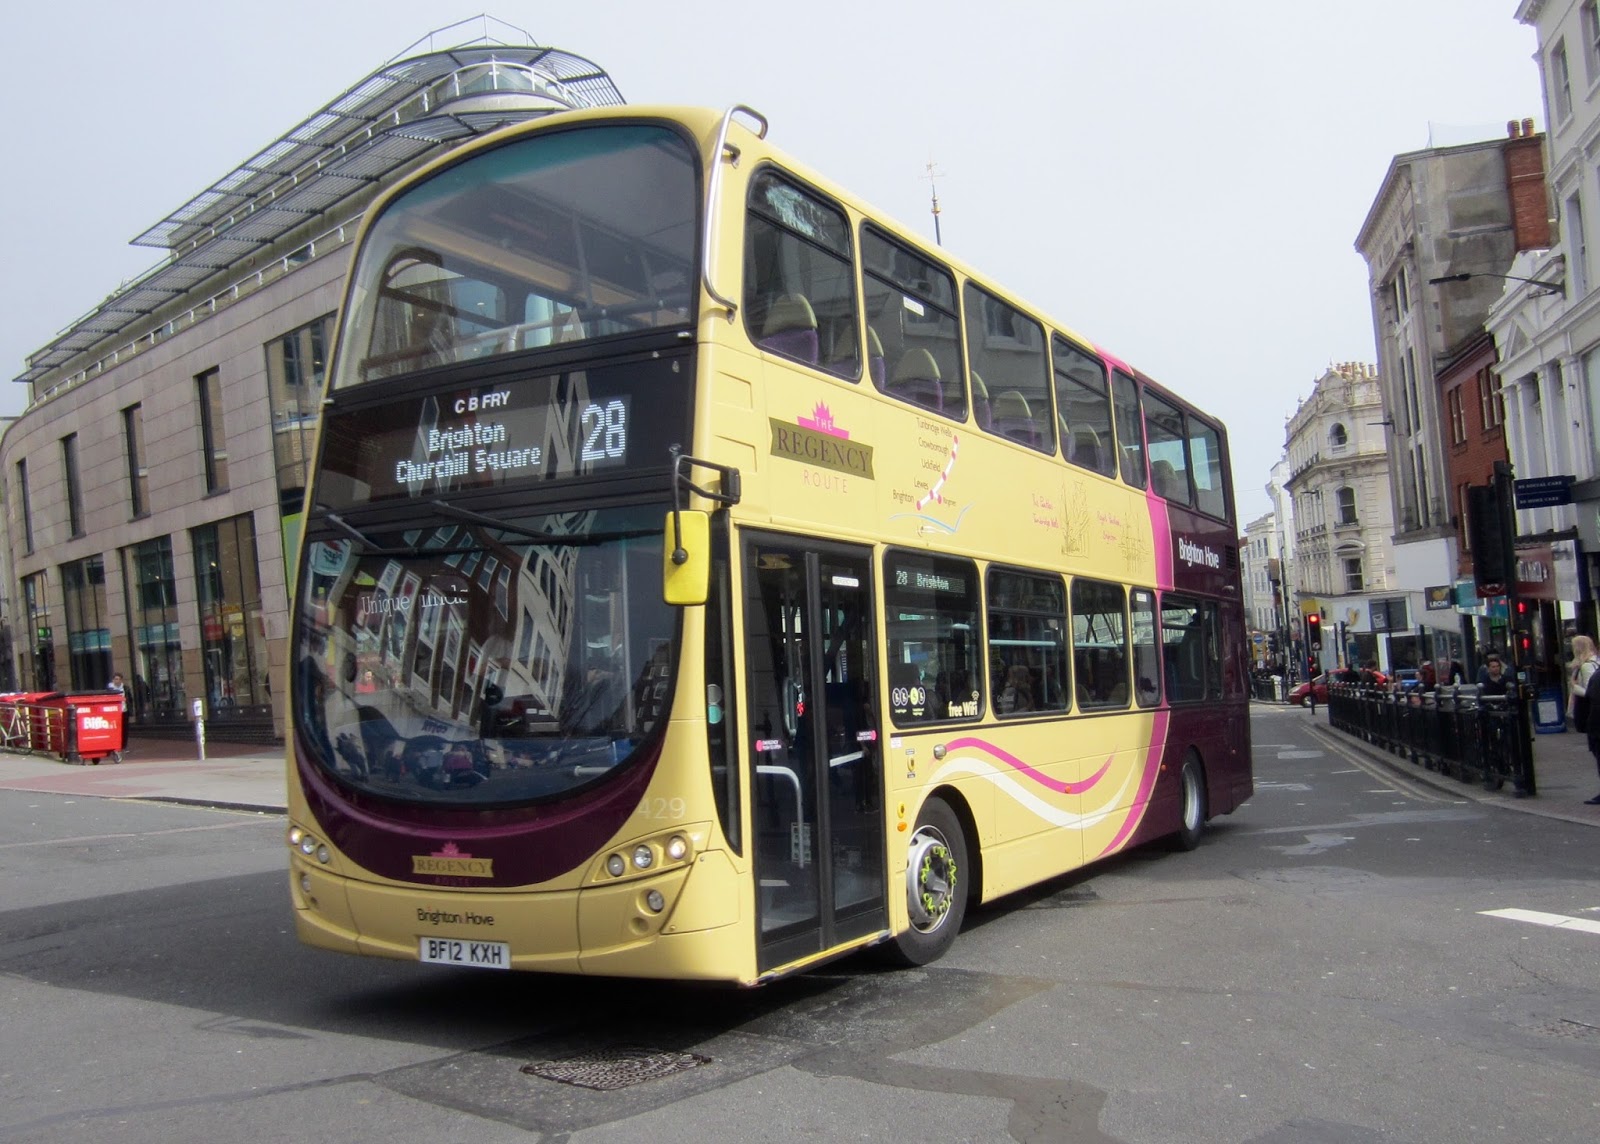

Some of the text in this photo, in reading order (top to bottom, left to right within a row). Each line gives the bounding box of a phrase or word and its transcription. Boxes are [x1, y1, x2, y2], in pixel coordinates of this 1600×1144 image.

[454, 390, 511, 414] C B FRY
[581, 400, 626, 461] 28
[815, 416, 834, 431] THE
[429, 422, 506, 452] Brighton
[777, 427, 870, 472] REGENCY
[396, 447, 541, 483] Churchill Square
[803, 469, 849, 494] ROUTE
[913, 476, 929, 490] Lewes
[892, 488, 915, 504] Brighton
[1179, 536, 1219, 569] Brighton Hove
[896, 570, 949, 590] 28 Brighton
[361, 594, 410, 617] Unique
[1429, 600, 1448, 608] LEON
[948, 700, 978, 718] free WiFi
[638, 796, 686, 819] 429
[416, 859, 487, 874] REGENCY
[416, 906, 496, 926] Brighton Hove
[428, 940, 502, 965] BF12 KXH
